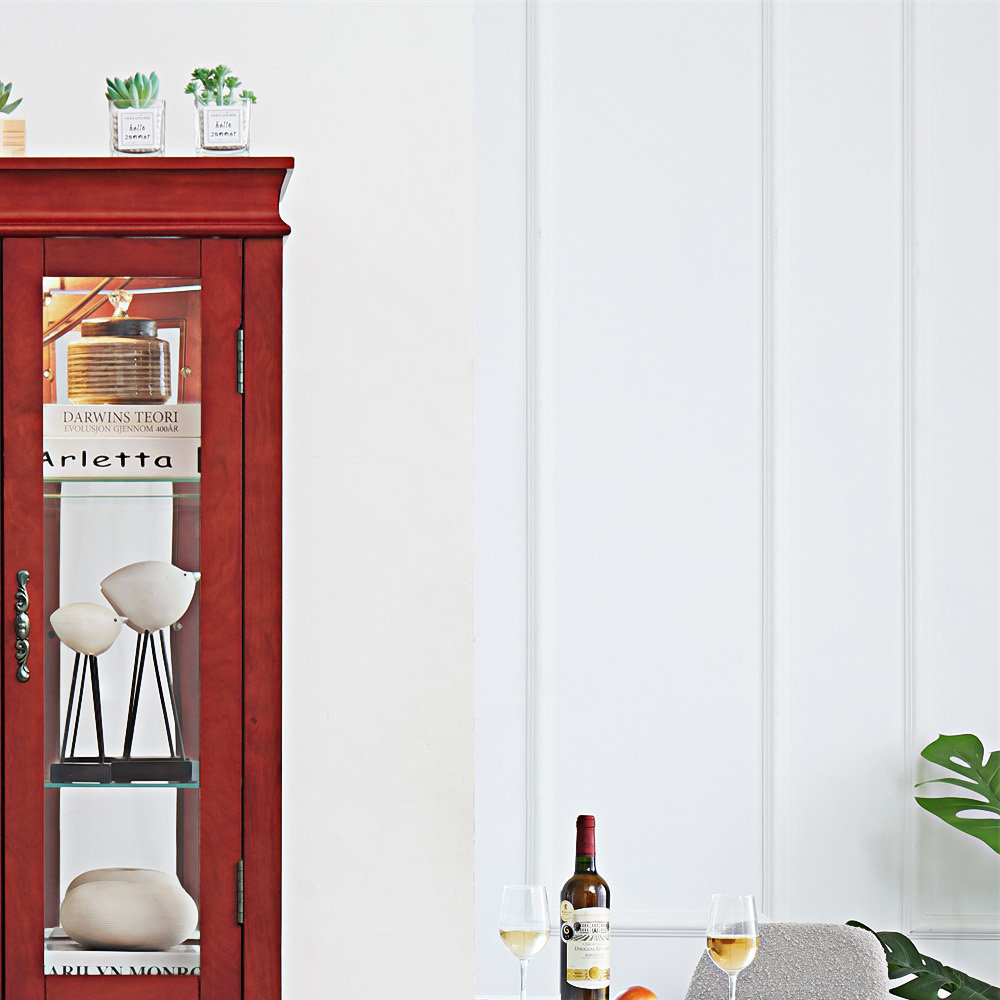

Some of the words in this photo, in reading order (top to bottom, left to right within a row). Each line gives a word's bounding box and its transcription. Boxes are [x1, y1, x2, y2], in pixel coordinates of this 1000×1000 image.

[63, 411, 131, 423] DARWINS
[135, 411, 178, 423] TEORI
[64, 425, 111, 434] EVOLUSJON
[113, 425, 154, 434] GJENNOM
[43, 450, 173, 468] Arletta
[49, 966, 123, 975] ARILYN
